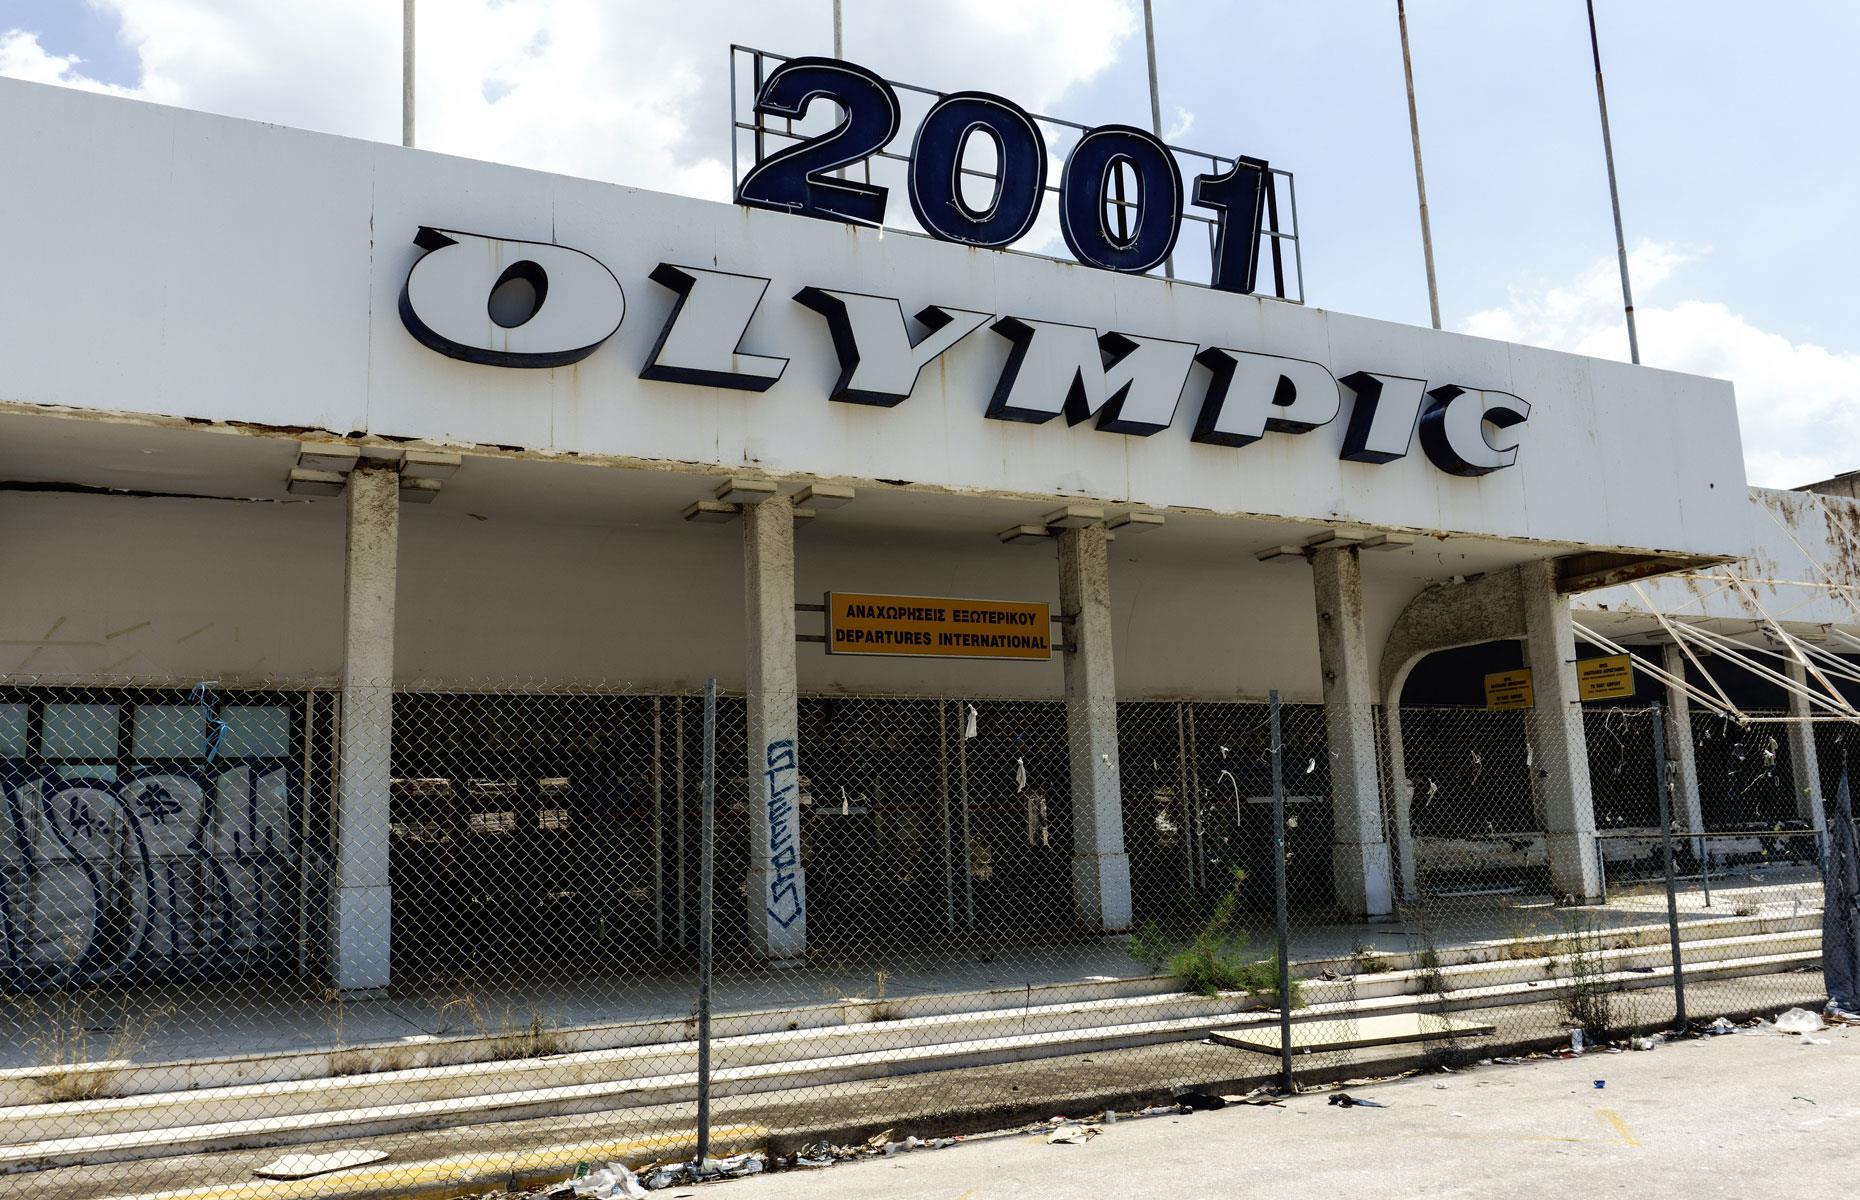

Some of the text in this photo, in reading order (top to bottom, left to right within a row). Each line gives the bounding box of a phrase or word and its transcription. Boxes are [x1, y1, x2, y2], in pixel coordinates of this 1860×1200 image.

[733, 56, 1269, 295] 2001
[399, 225, 1532, 477] OLYMPIC
[835, 628, 1048, 649] DEPARTURES INTERNATIONAL
[846, 604, 1037, 626] ΑΝΑΧΩΡΗΣΕΙΣ ΕΞΩΤΕΡΙΚΟΥ
